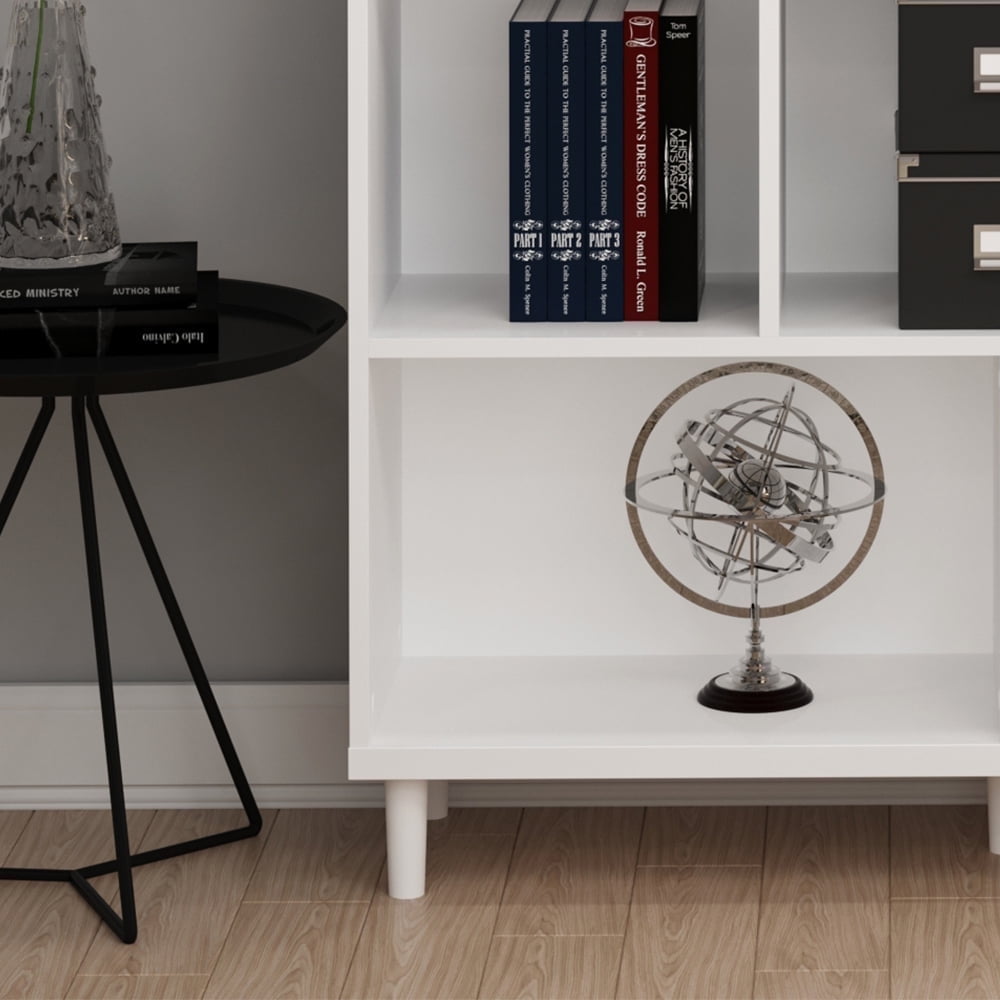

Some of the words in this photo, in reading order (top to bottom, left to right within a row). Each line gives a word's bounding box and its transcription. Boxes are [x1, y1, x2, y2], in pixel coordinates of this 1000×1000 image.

[665, 30, 691, 40] Speer
[670, 22, 687, 30] Tom
[523, 88, 532, 99] TO
[562, 88, 571, 99] TO
[600, 88, 609, 99] TO
[636, 53, 647, 141] GENTLEMAN'S
[523, 101, 532, 114] THE
[562, 101, 571, 114] THE
[600, 101, 609, 114] THE
[523, 115, 532, 143] PERFECT
[562, 115, 571, 143] PERFECT
[600, 115, 609, 143] PERFECT
[678, 127, 688, 137] A
[670, 127, 678, 163] MEN'S
[523, 145, 533, 179] WOMEN'S
[562, 145, 572, 179] WOMEN'S
[600, 145, 610, 179] WOMEN'S
[636, 143, 647, 181] DRESS
[678, 139, 688, 189] HISTORY
[670, 164, 678, 210] FASHION
[523, 180, 532, 216] CLOTHING
[562, 180, 571, 216] CLOTHING
[600, 180, 609, 216] CLOTHING
[636, 184, 647, 218] CODE
[678, 191, 688, 209] OF
[514, 233, 537, 248] PART
[539, 233, 543, 248] 1
[551, 233, 574, 248] PART
[576, 233, 582, 248] 2
[589, 233, 612, 248] PART
[614, 233, 620, 248] 3
[636, 230, 647, 266] Ronald
[636, 268, 647, 279] L.
[26, 287, 80, 298] MINISTRY
[112, 287, 151, 296] AUTHOR
[154, 286, 181, 295] NAME
[636, 281, 647, 312] Green
[142, 333, 179, 344] Calvino
[181, 332, 204, 344] Italo
